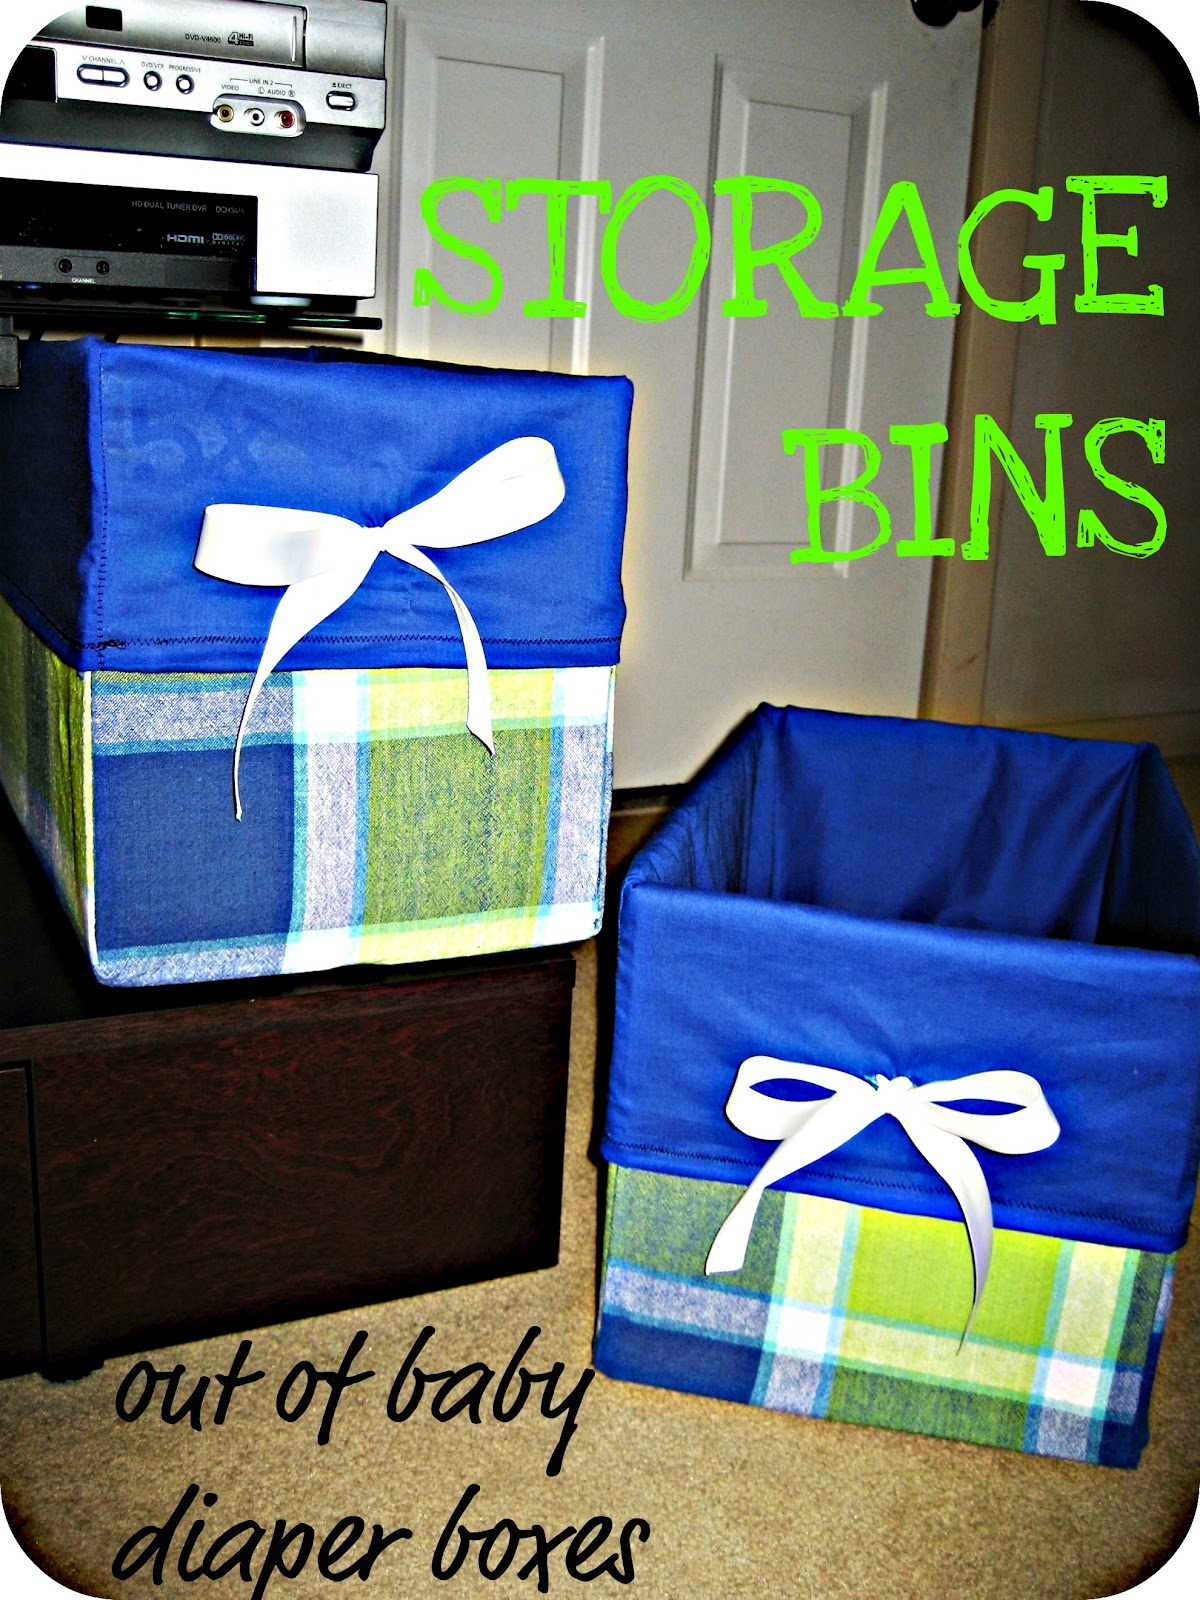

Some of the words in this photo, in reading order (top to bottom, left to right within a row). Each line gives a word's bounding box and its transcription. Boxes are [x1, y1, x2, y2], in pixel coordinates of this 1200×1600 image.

[185, 33, 222, 44] DVD-V4600
[88, 56, 118, 65] CHANNEL
[141, 61, 165, 69] DVD/VCR
[168, 64, 202, 73] PROGRESSIVE
[221, 84, 240, 92] VIDEO
[267, 88, 286, 96] AUDIO
[131, 200, 143, 208] HD
[143, 201, 165, 210] DUAL
[166, 202, 192, 211] TUNER
[192, 204, 208, 212] DVR
[166, 233, 205, 245] HDMI
